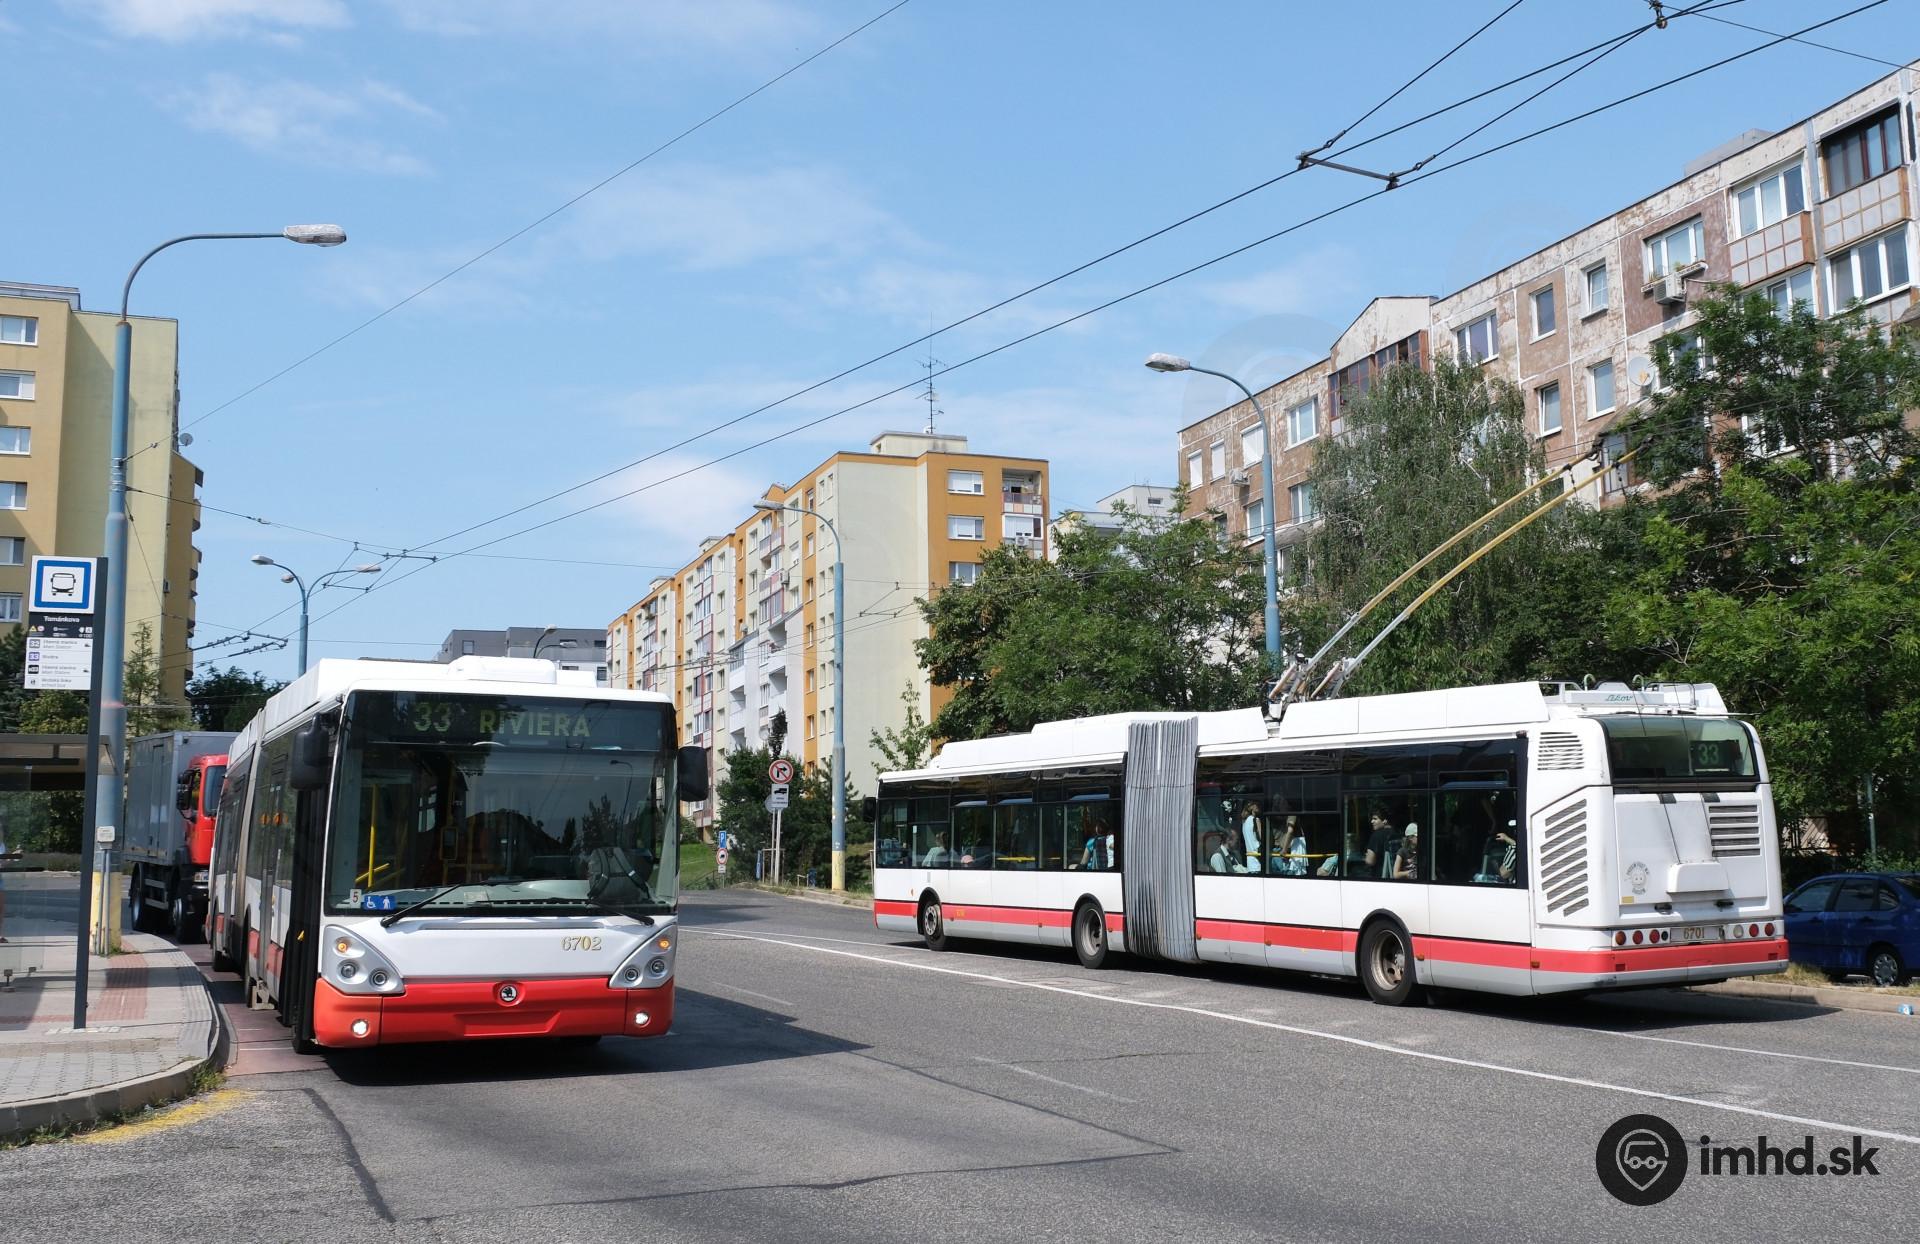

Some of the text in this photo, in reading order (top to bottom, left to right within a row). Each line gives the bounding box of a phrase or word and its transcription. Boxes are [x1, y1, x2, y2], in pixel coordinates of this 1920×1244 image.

[414, 701, 590, 737] 33 RIVIERA
[1699, 743, 1719, 765] 33
[352, 891, 359, 903] 5
[1683, 926, 1705, 940] 6701
[561, 936, 602, 951] 6702
